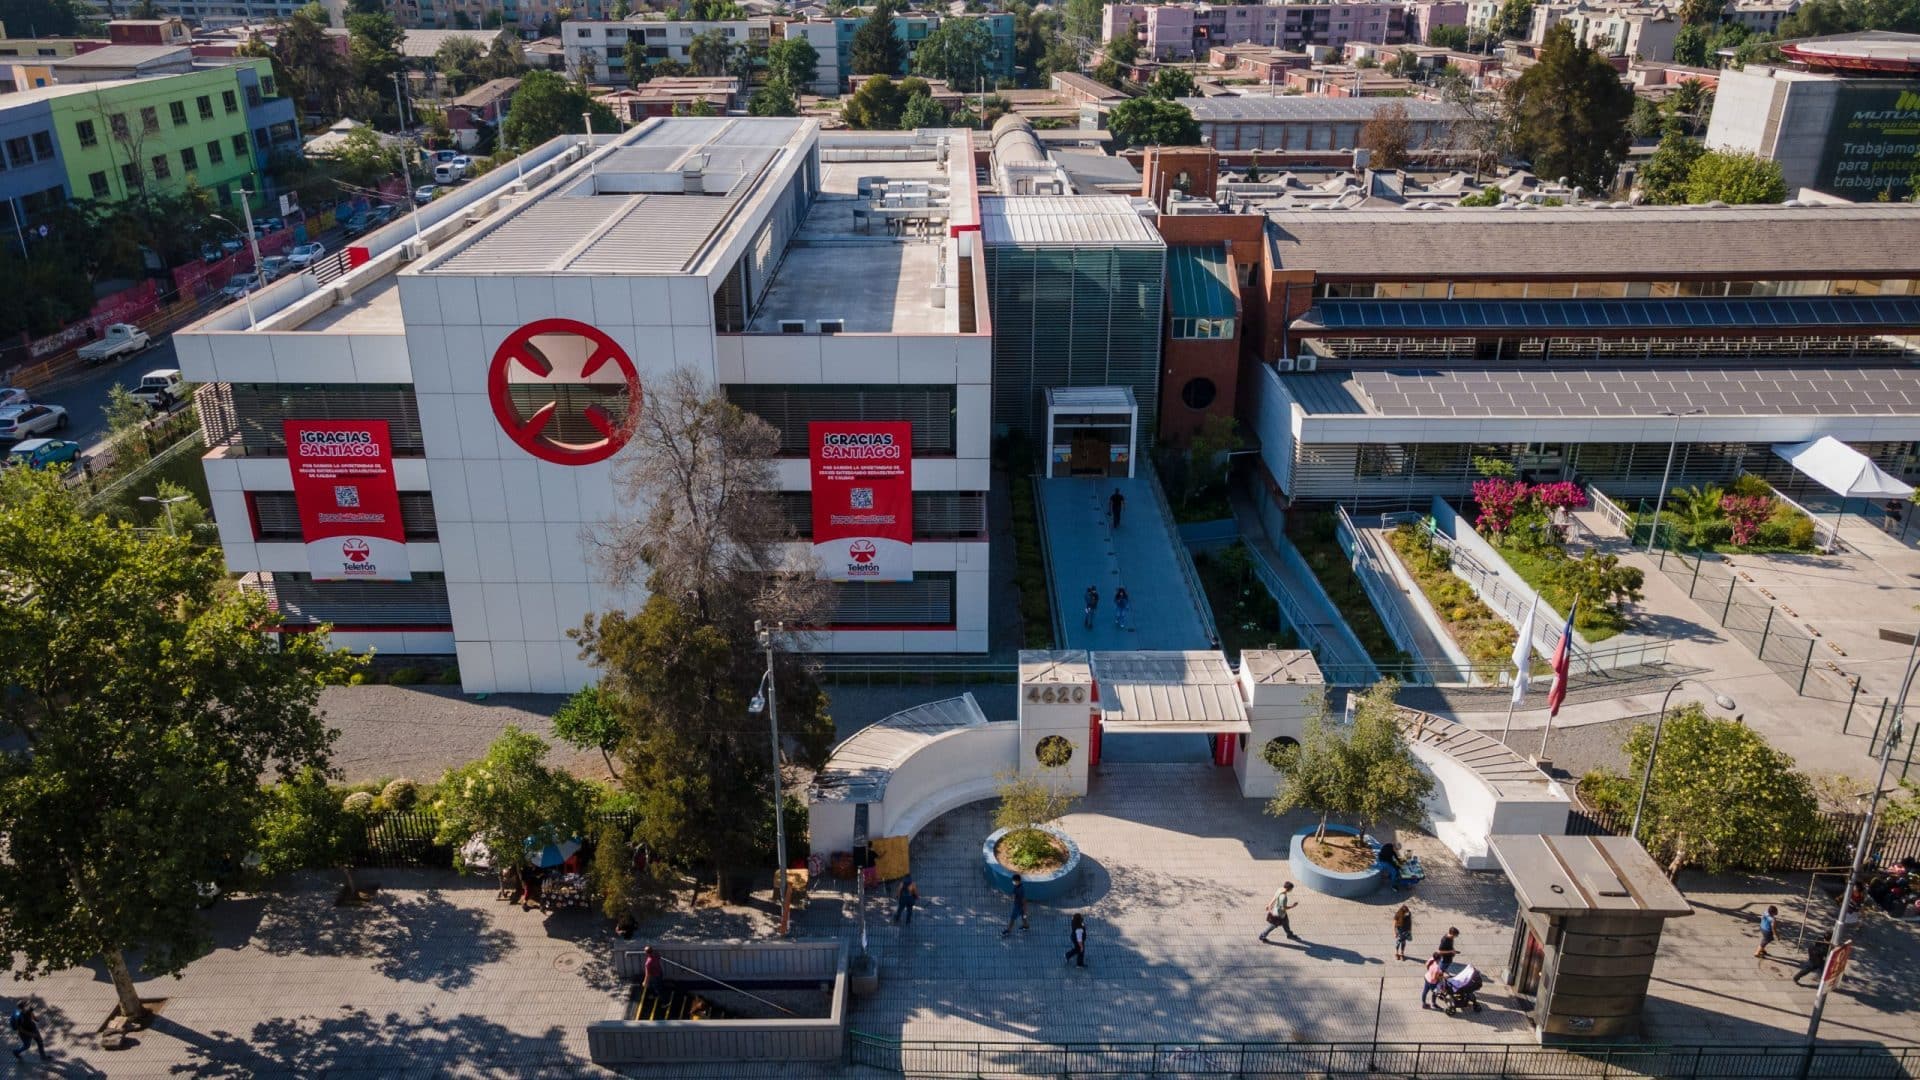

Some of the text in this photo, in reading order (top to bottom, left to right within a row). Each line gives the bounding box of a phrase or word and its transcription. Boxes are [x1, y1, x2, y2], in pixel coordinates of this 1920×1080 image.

[1853, 111, 1920, 119] MUTUA
[1866, 120, 1920, 130] segurida
[1837, 161, 1869, 174] para
[1834, 175, 1911, 190] trabajador
[300, 443, 379, 456] SANTIAGO!
[822, 446, 900, 458] SANTIAGO!
[343, 562, 376, 571] Teletón
[847, 563, 880, 572] Teletón
[1027, 686, 1086, 704] 4620
